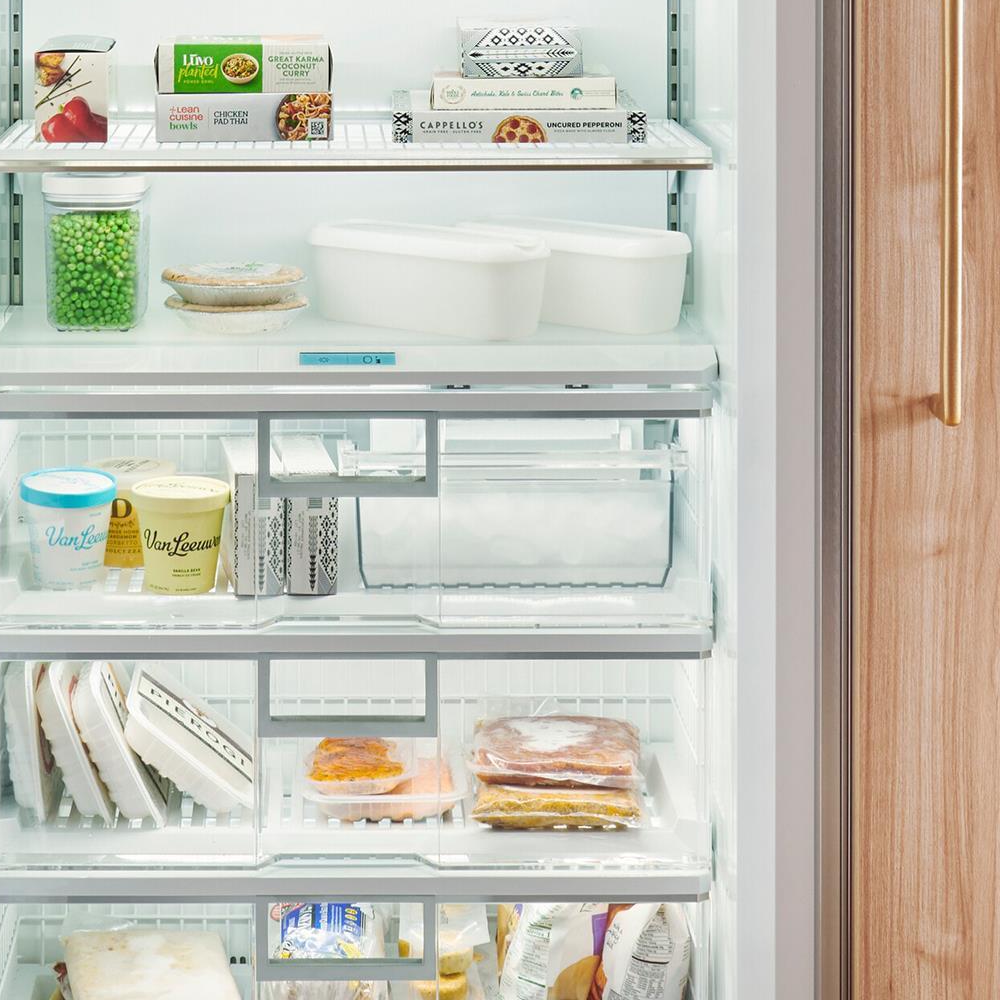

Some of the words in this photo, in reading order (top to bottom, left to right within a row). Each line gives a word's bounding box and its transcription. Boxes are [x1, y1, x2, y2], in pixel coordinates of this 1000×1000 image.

[267, 55, 293, 63] GREAT
[295, 55, 325, 63] KARMA
[178, 63, 219, 83] planted
[213, 110, 249, 118] CHICKEN
[169, 121, 198, 130] bowls
[419, 121, 484, 129] CAPPELLO'S
[45, 525, 79, 546] Van
[74, 524, 107, 551] Leeu
[143, 528, 172, 551] Van
[150, 687, 246, 766] PIEROGI
